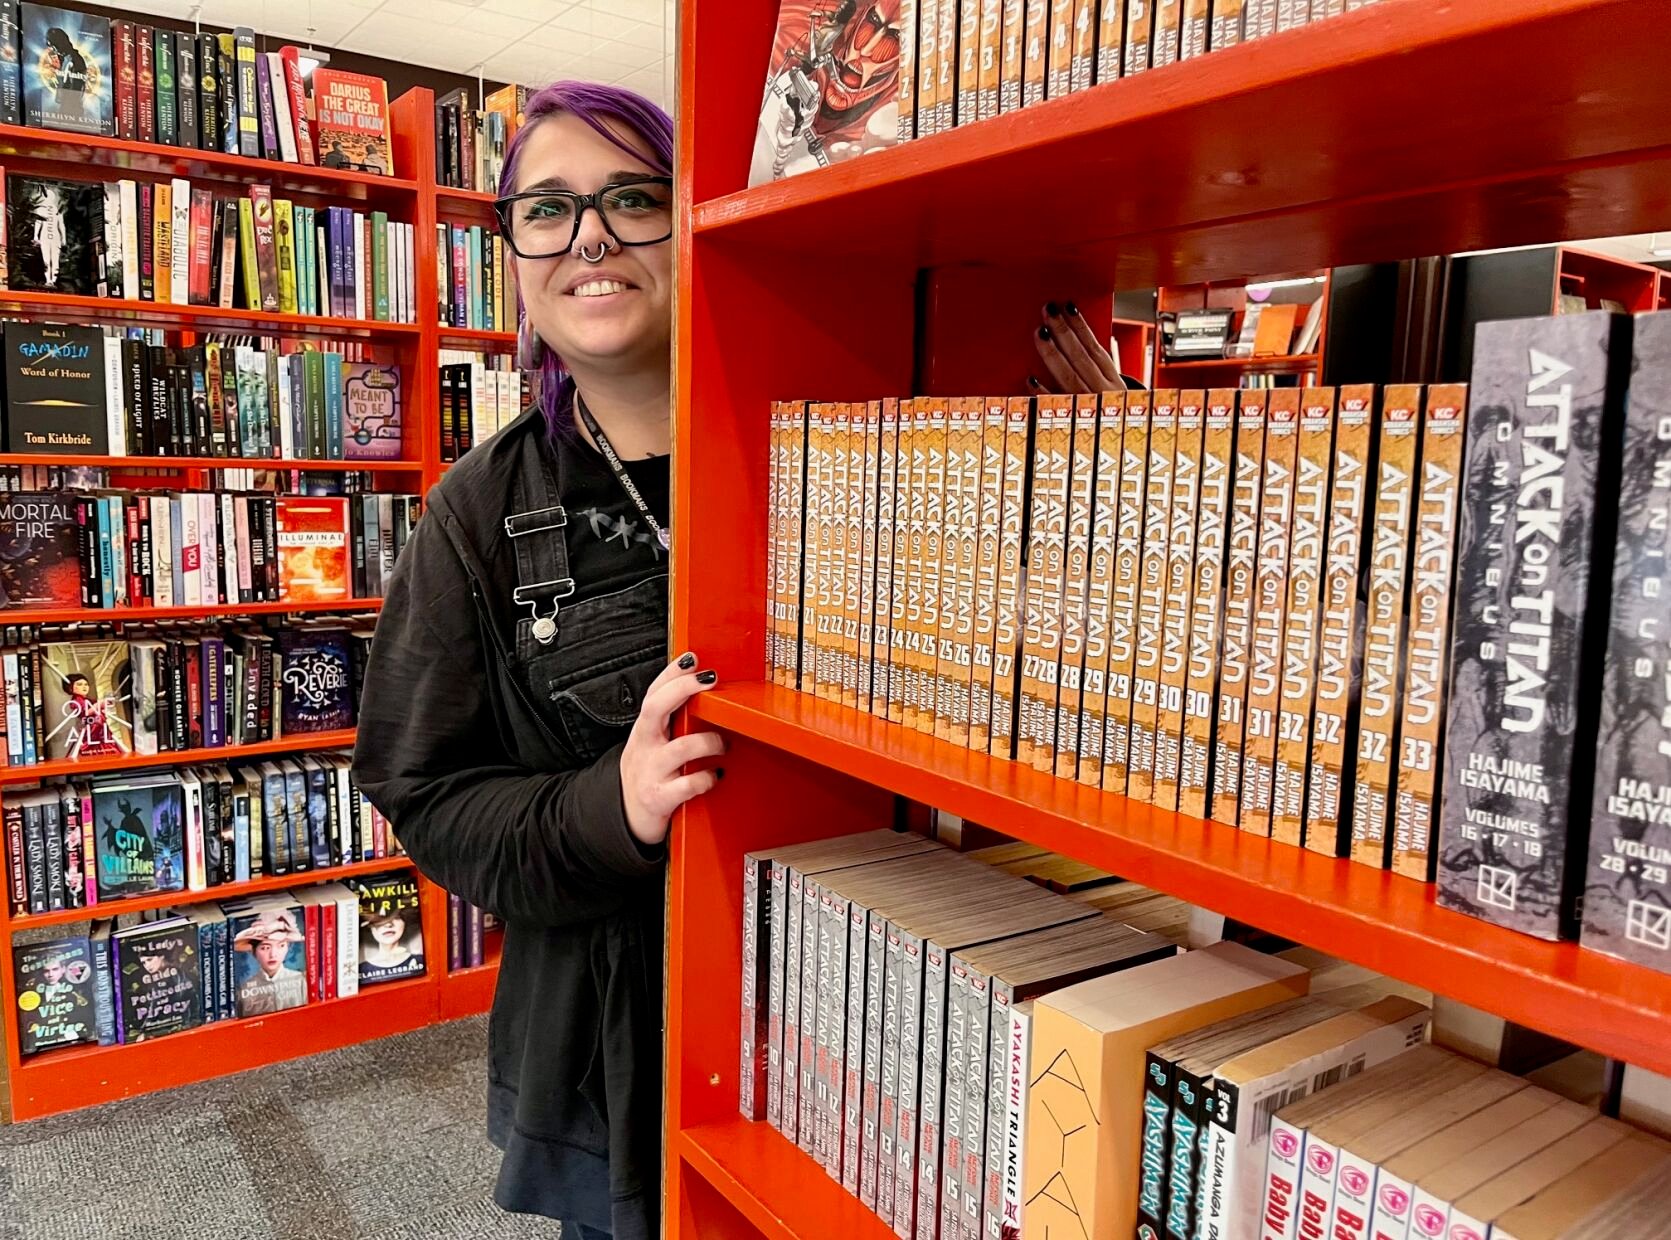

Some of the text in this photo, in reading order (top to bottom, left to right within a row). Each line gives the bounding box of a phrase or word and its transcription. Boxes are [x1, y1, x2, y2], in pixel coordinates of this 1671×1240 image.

[322, 95, 380, 116] THE GREAT
[330, 82, 370, 100] DARIUS
[320, 109, 384, 131] IS NOT OKAY
[21, 368, 90, 379] Word of Honor
[350, 388, 388, 402] MEANT
[354, 402, 384, 414] TO BE
[25, 432, 91, 445] Tom Kirkbride
[596, 434, 623, 472] BOOKMANS
[620, 473, 648, 511] BOOKMANS
[0, 503, 72, 520] MORTAL
[16, 522, 55, 538] FIRE
[188, 521, 198, 567] OVER YOU
[280, 534, 343, 542] ILLUMINAE
[1480, 422, 1512, 660] OMNIBUS
[1501, 348, 1574, 733] ATTACK on TITAN
[998, 451, 1023, 644] ATTACK on TITAN
[1224, 452, 1259, 683] ATTACK on TITAN
[1283, 456, 1324, 699] ATTACK on TITAN
[1364, 461, 1409, 717] ATTACK on TITAN
[1407, 462, 1454, 725] ATTACK on TITAN
[906, 630, 920, 651] 24
[974, 643, 991, 667] 26
[996, 654, 1012, 677] 27
[1038, 659, 1057, 684] 28
[284, 662, 348, 702] REVERIE
[1083, 668, 1104, 694] 29
[62, 697, 116, 718] ONE
[247, 668, 257, 728] Invaded
[1158, 684, 1181, 713] 30
[1220, 695, 1241, 724] 31
[992, 693, 1002, 737] ISAYAMA
[1000, 700, 1011, 736] HAJIME
[1249, 708, 1272, 738] 31
[1279, 710, 1305, 742] 32
[64, 723, 117, 748] ALL
[1359, 729, 1388, 763] 32
[1213, 743, 1227, 794] ISAYAMA
[1402, 736, 1432, 771] 33
[1468, 752, 1544, 784] HAJIME
[1226, 751, 1239, 794] HAJIME
[1460, 768, 1550, 804] ISAYAMA
[1272, 761, 1288, 816] ISAYAMA
[1286, 770, 1302, 816] HAJIME
[1619, 777, 1671, 805] HAJI
[1353, 783, 1369, 840] ISAYAMA
[1368, 792, 1385, 841] HAJIME
[1396, 792, 1412, 851] ISAYAMA
[1465, 807, 1539, 838] VOLUMES
[1608, 796, 1671, 826] ISAYA
[116, 830, 144, 852] CITY
[1412, 802, 1430, 851] HAJIME
[1492, 831, 1509, 848] 17
[1523, 840, 1542, 858] 18
[102, 855, 154, 875] VILLAINS
[1600, 854, 1667, 885] 28 29
[96, 951, 108, 968] THIS
[142, 967, 178, 985] Guide
[39, 1002, 74, 1018] Vice
[136, 999, 191, 1020] Piracy
[969, 1013, 982, 1085] ATTACK
[1005, 1019, 1022, 1197] AYAKASHI TRIANGLE
[921, 1159, 934, 1185] 14
[1210, 1132, 1226, 1217] AZUMANGA
[946, 1175, 958, 1200] 15
[965, 1192, 977, 1218] 15
[1265, 1174, 1292, 1235] Baby
[986, 1210, 1000, 1235] 16
